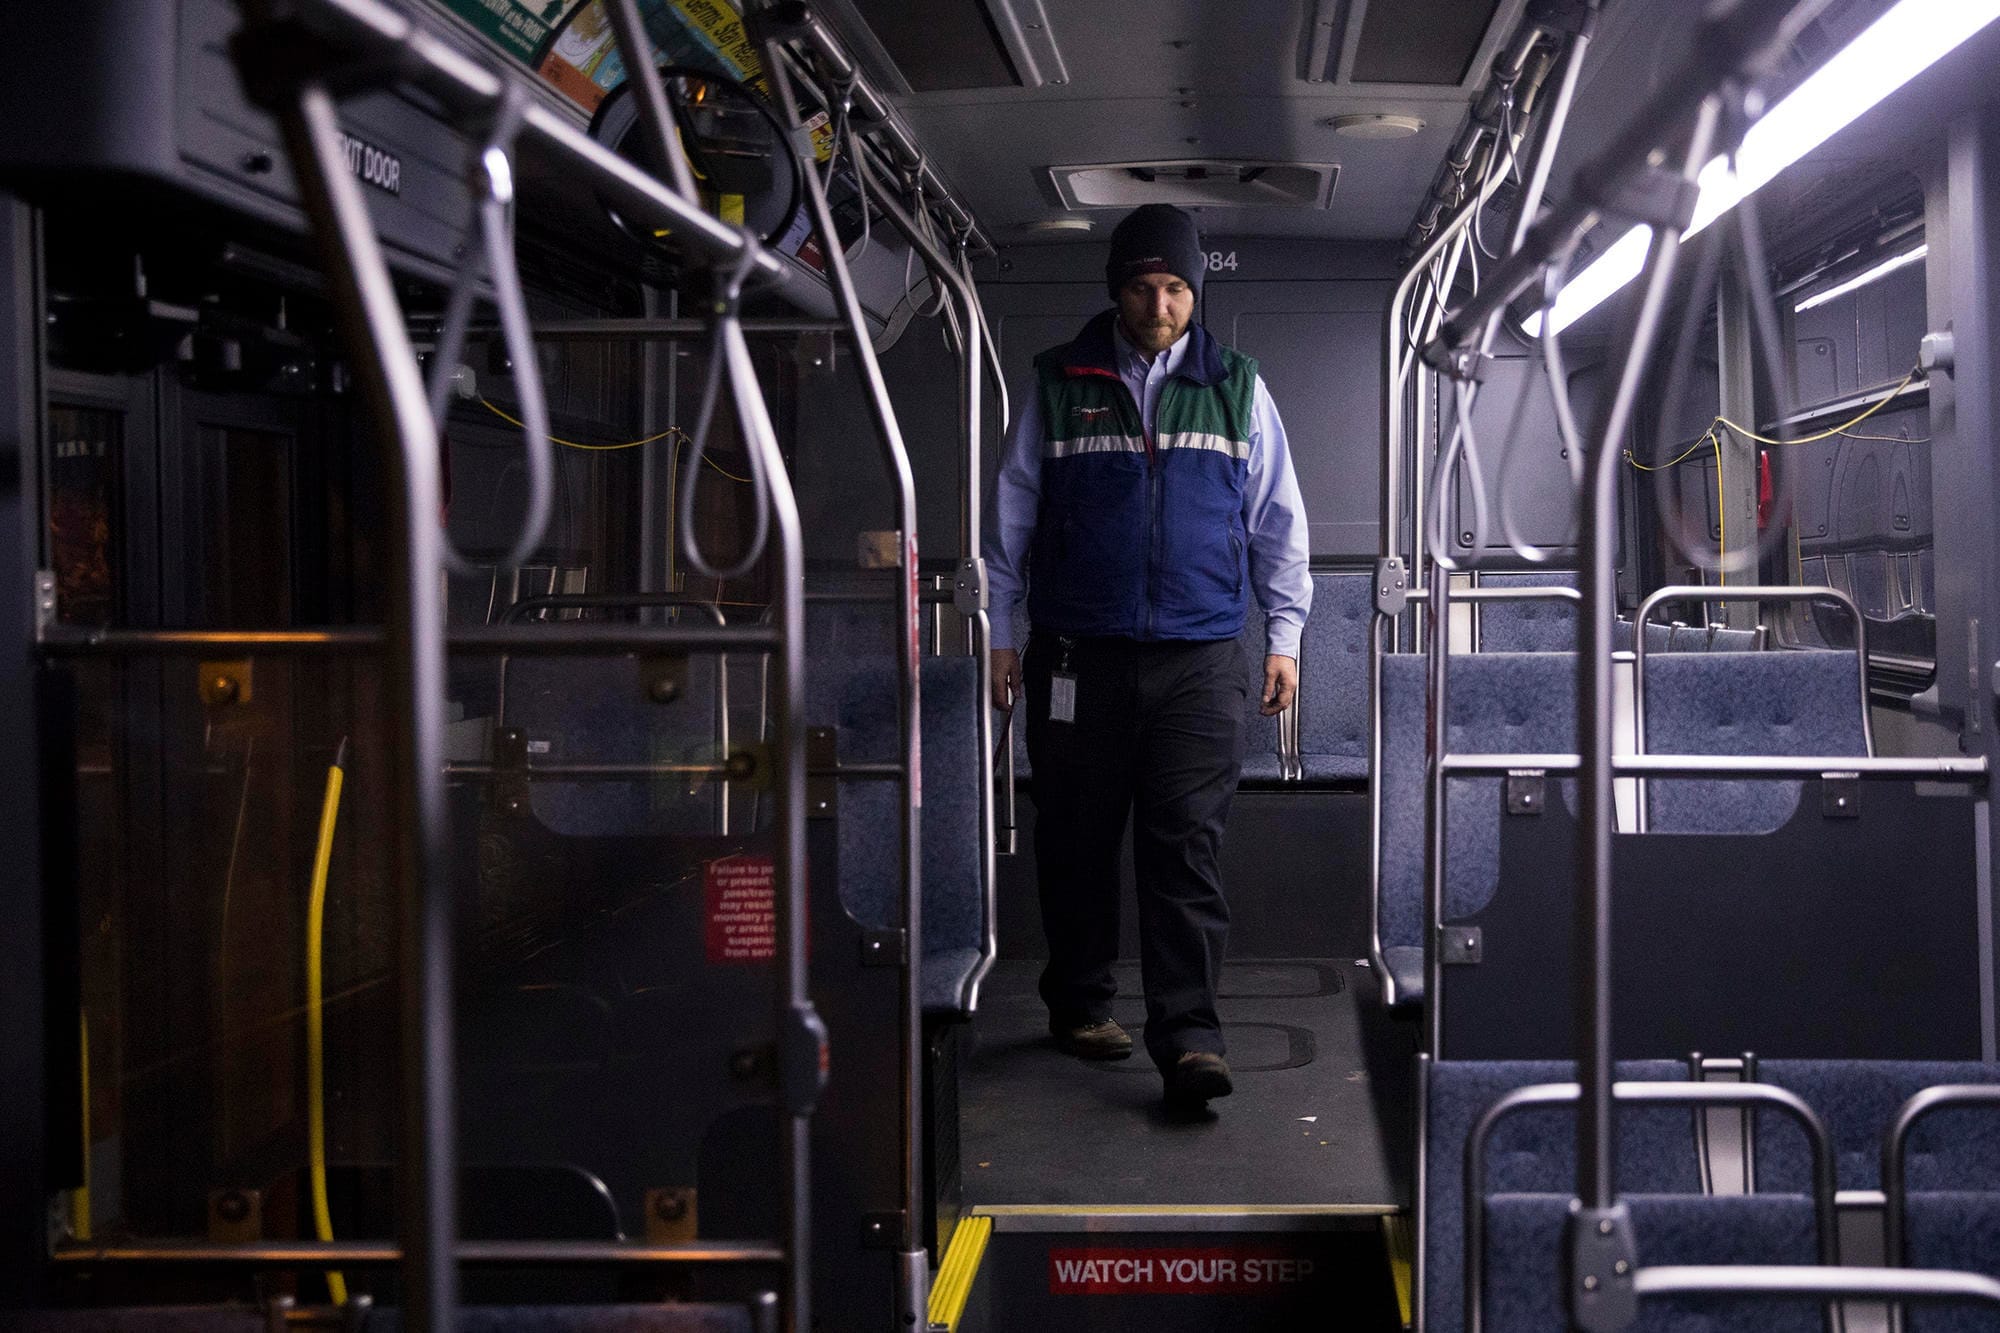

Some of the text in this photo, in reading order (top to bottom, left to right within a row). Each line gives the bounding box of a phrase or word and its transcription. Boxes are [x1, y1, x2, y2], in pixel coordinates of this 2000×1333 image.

[364, 145, 400, 193] DOOR
[710, 864, 775, 876] Failure to pa
[716, 877, 769, 888] or present
[719, 902, 742, 912] may
[713, 912, 762, 923] monetary
[725, 926, 736, 934] or
[738, 924, 769, 934] arrest
[724, 948, 775, 957] from serv
[1055, 1259, 1315, 1284] WATCH YOUR STEP
